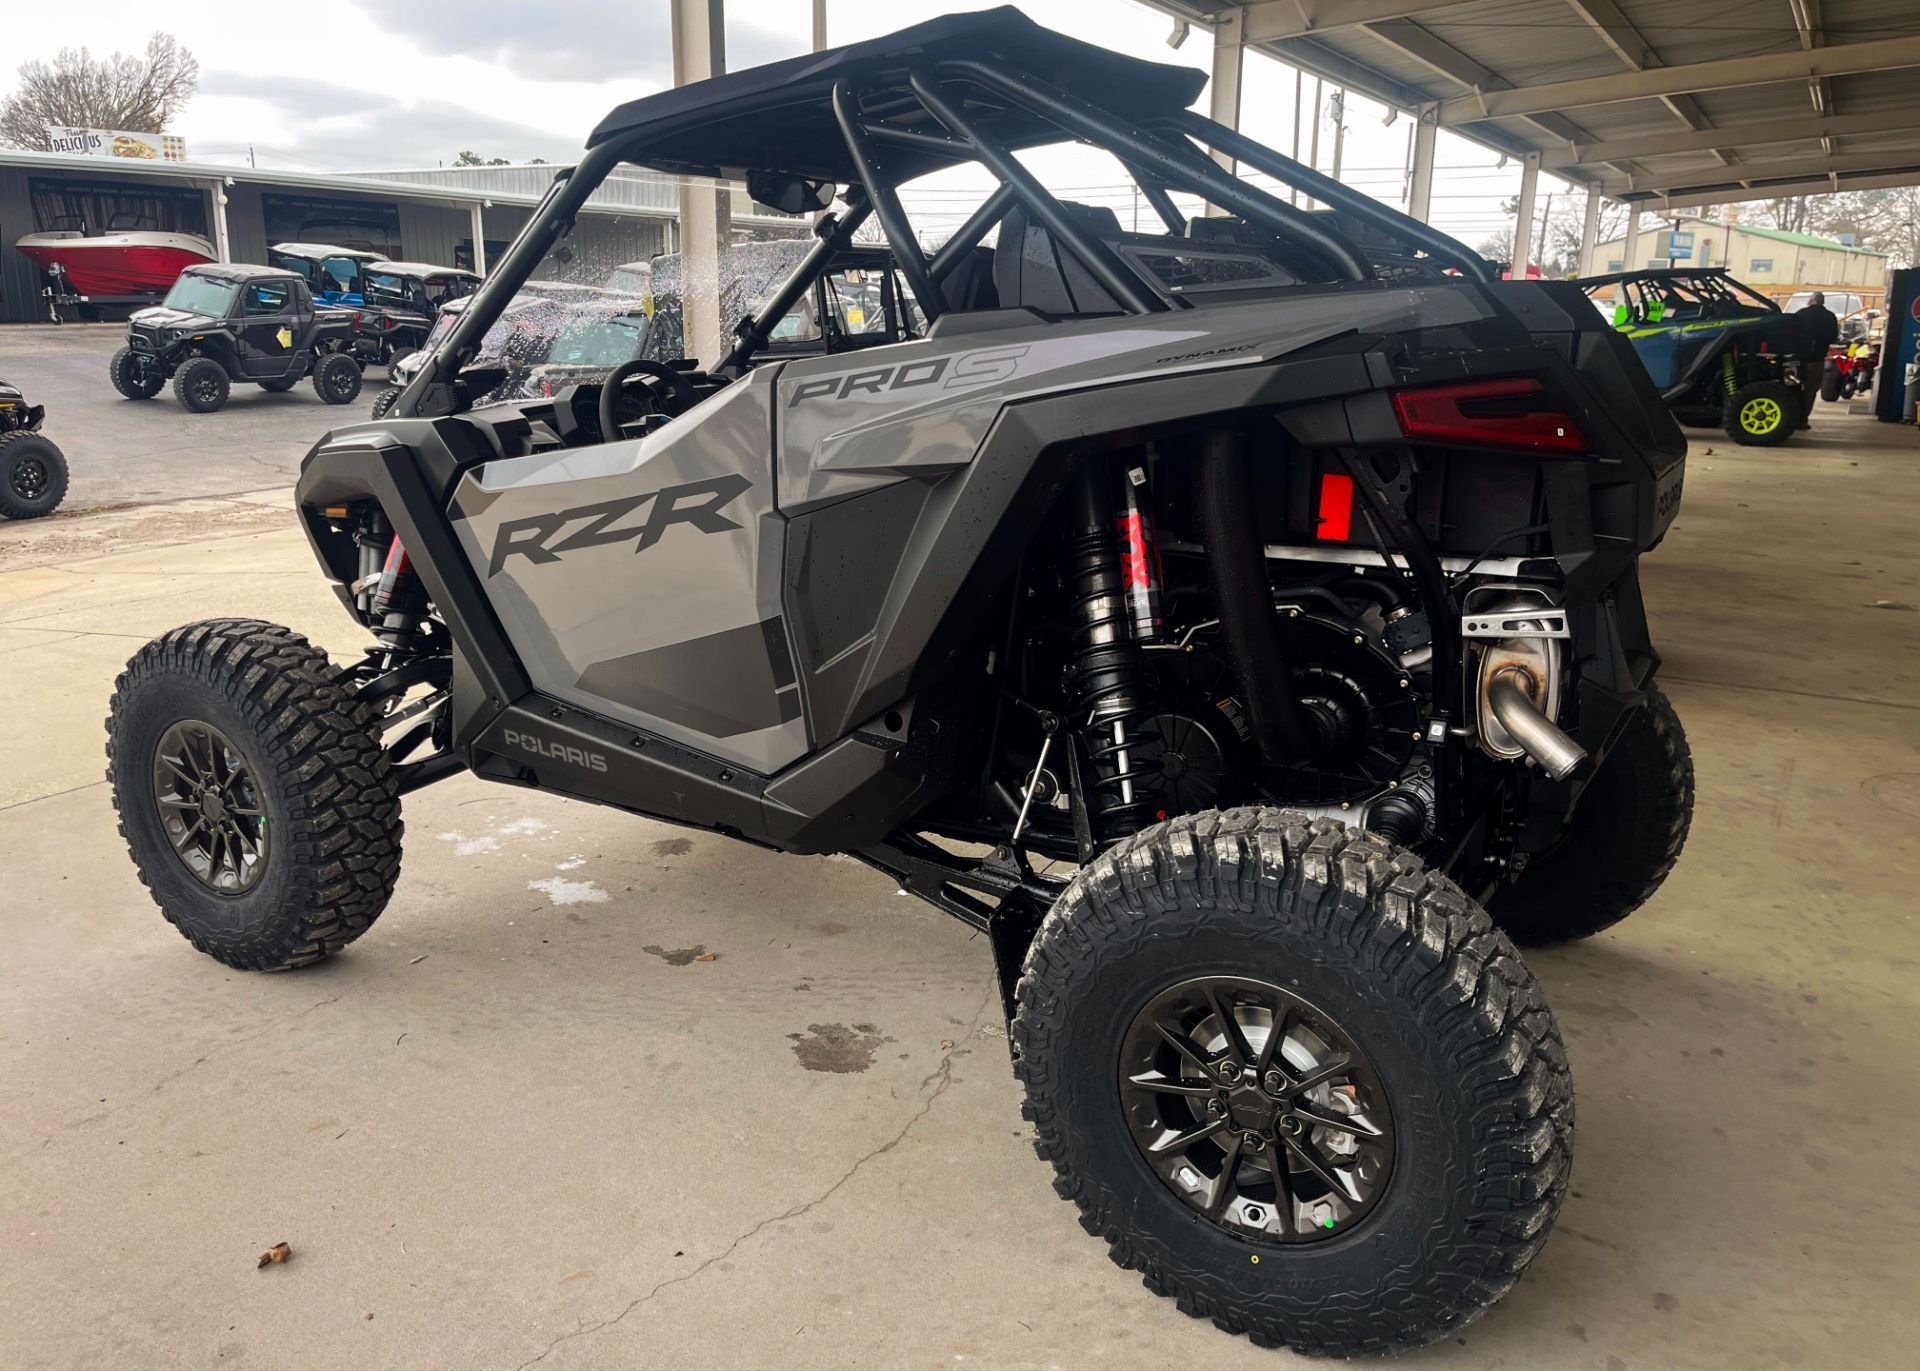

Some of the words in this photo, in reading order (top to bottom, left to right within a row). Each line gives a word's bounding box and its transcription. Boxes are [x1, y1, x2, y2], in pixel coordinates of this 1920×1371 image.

[53, 134, 102, 153] DELICIUS
[1156, 342, 1262, 363] DYNAMIX
[788, 357, 951, 408] PRO
[488, 473, 754, 579] RZR
[503, 729, 608, 773] POLARIS
